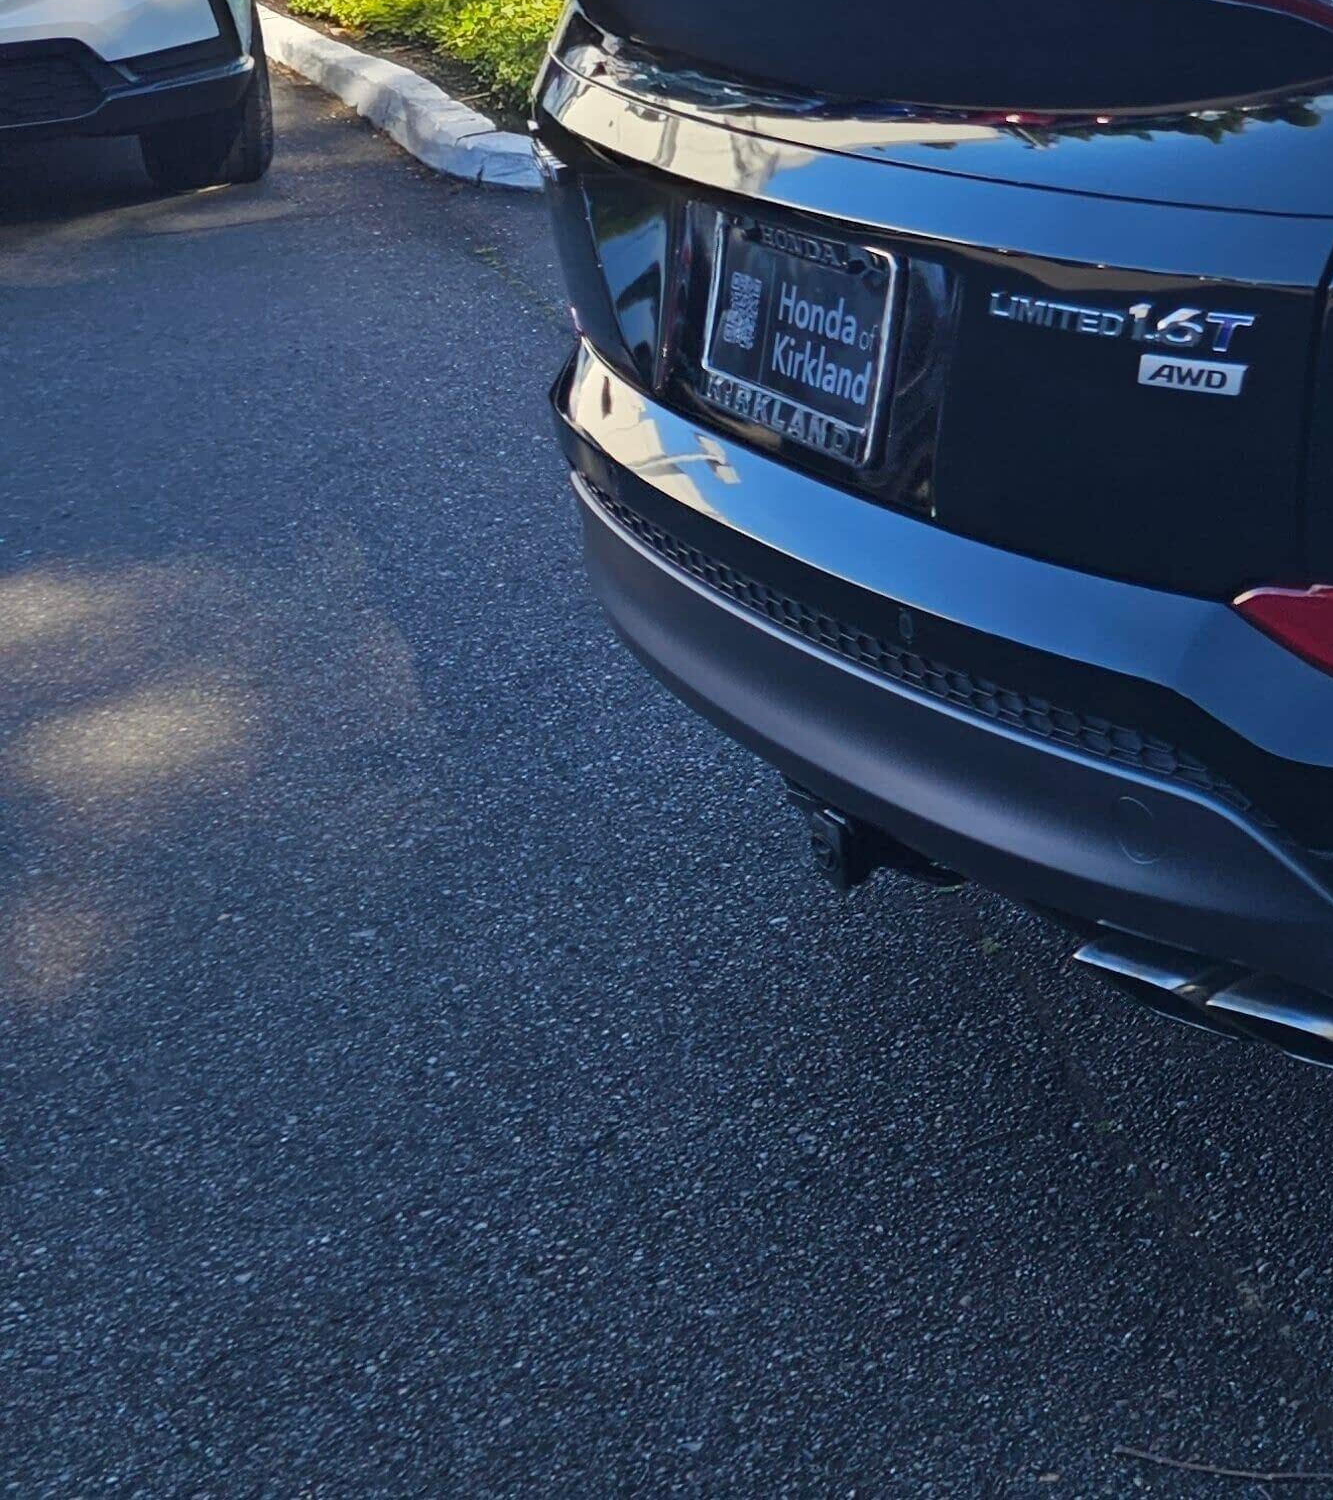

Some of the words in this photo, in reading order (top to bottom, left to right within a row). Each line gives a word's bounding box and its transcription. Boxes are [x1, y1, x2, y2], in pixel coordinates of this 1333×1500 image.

[760, 225, 845, 268] HONDA
[778, 281, 858, 347] Honda
[858, 324, 878, 352] of
[989, 291, 1124, 337] LIMITED
[771, 331, 873, 406] Kirkland
[1147, 363, 1228, 390] AWD
[705, 374, 850, 451] KIRKLAND
